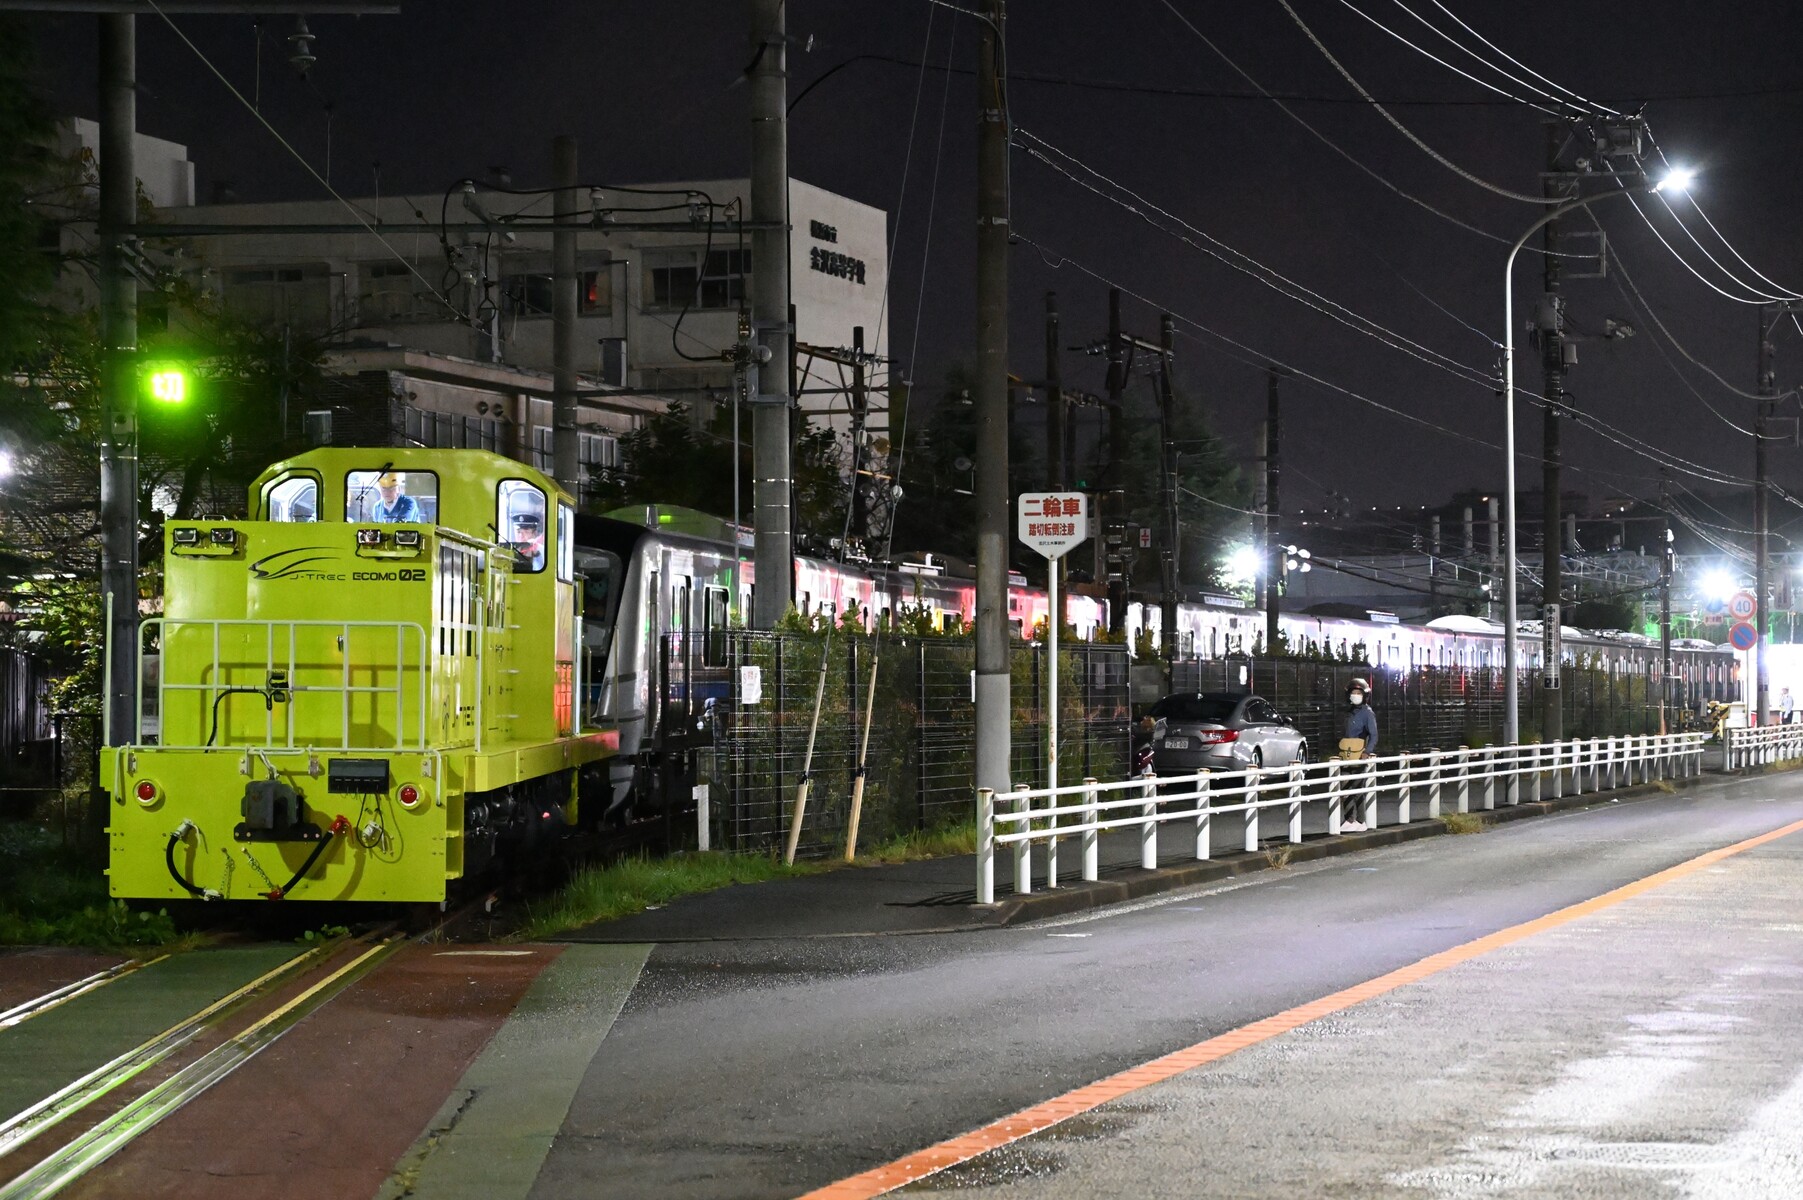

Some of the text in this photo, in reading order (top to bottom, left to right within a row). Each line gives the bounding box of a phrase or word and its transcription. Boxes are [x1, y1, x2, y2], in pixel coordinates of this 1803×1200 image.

[1024, 497, 1081, 518] 二輪車
[1028, 523, 1075, 536] 踏切転倒注意
[290, 569, 426, 581] J-TREC ECOMO 02
[1735, 600, 1752, 613] 40
